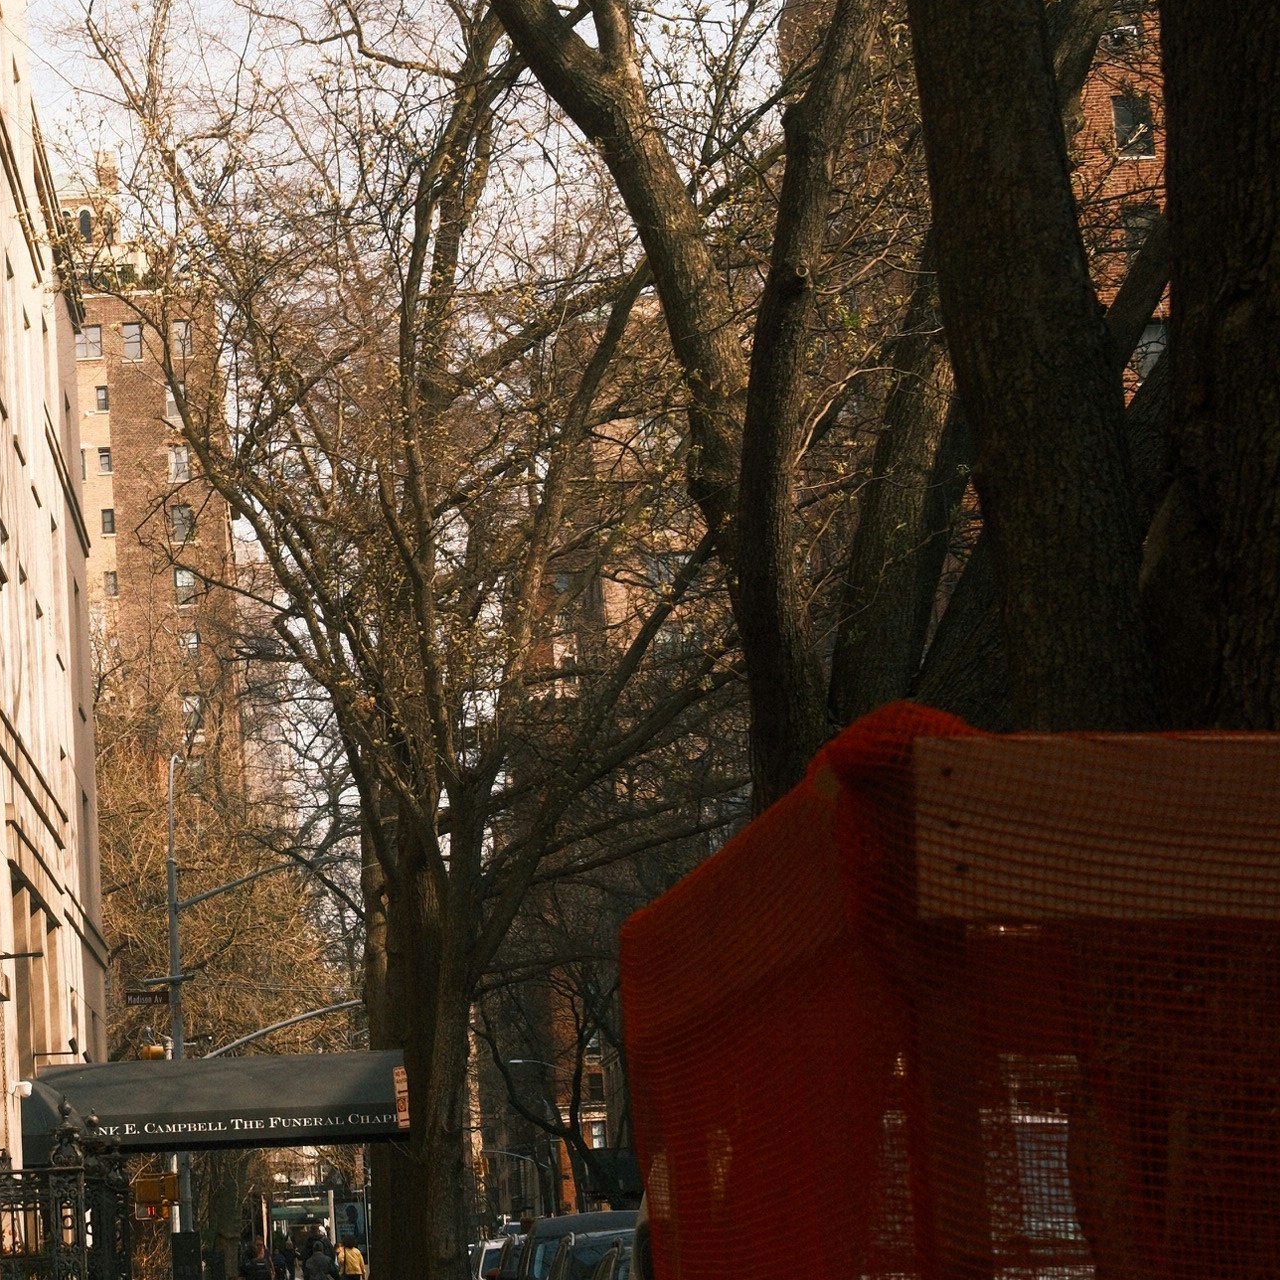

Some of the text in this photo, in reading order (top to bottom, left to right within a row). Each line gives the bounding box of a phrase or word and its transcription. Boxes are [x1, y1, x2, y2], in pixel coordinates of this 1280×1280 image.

[127, 995, 163, 1004] Madison Av
[124, 1123, 140, 1135] E.
[144, 1122, 227, 1134] CAMPBELL
[230, 1117, 265, 1130] THE
[269, 1116, 345, 1129] FUNERAL
